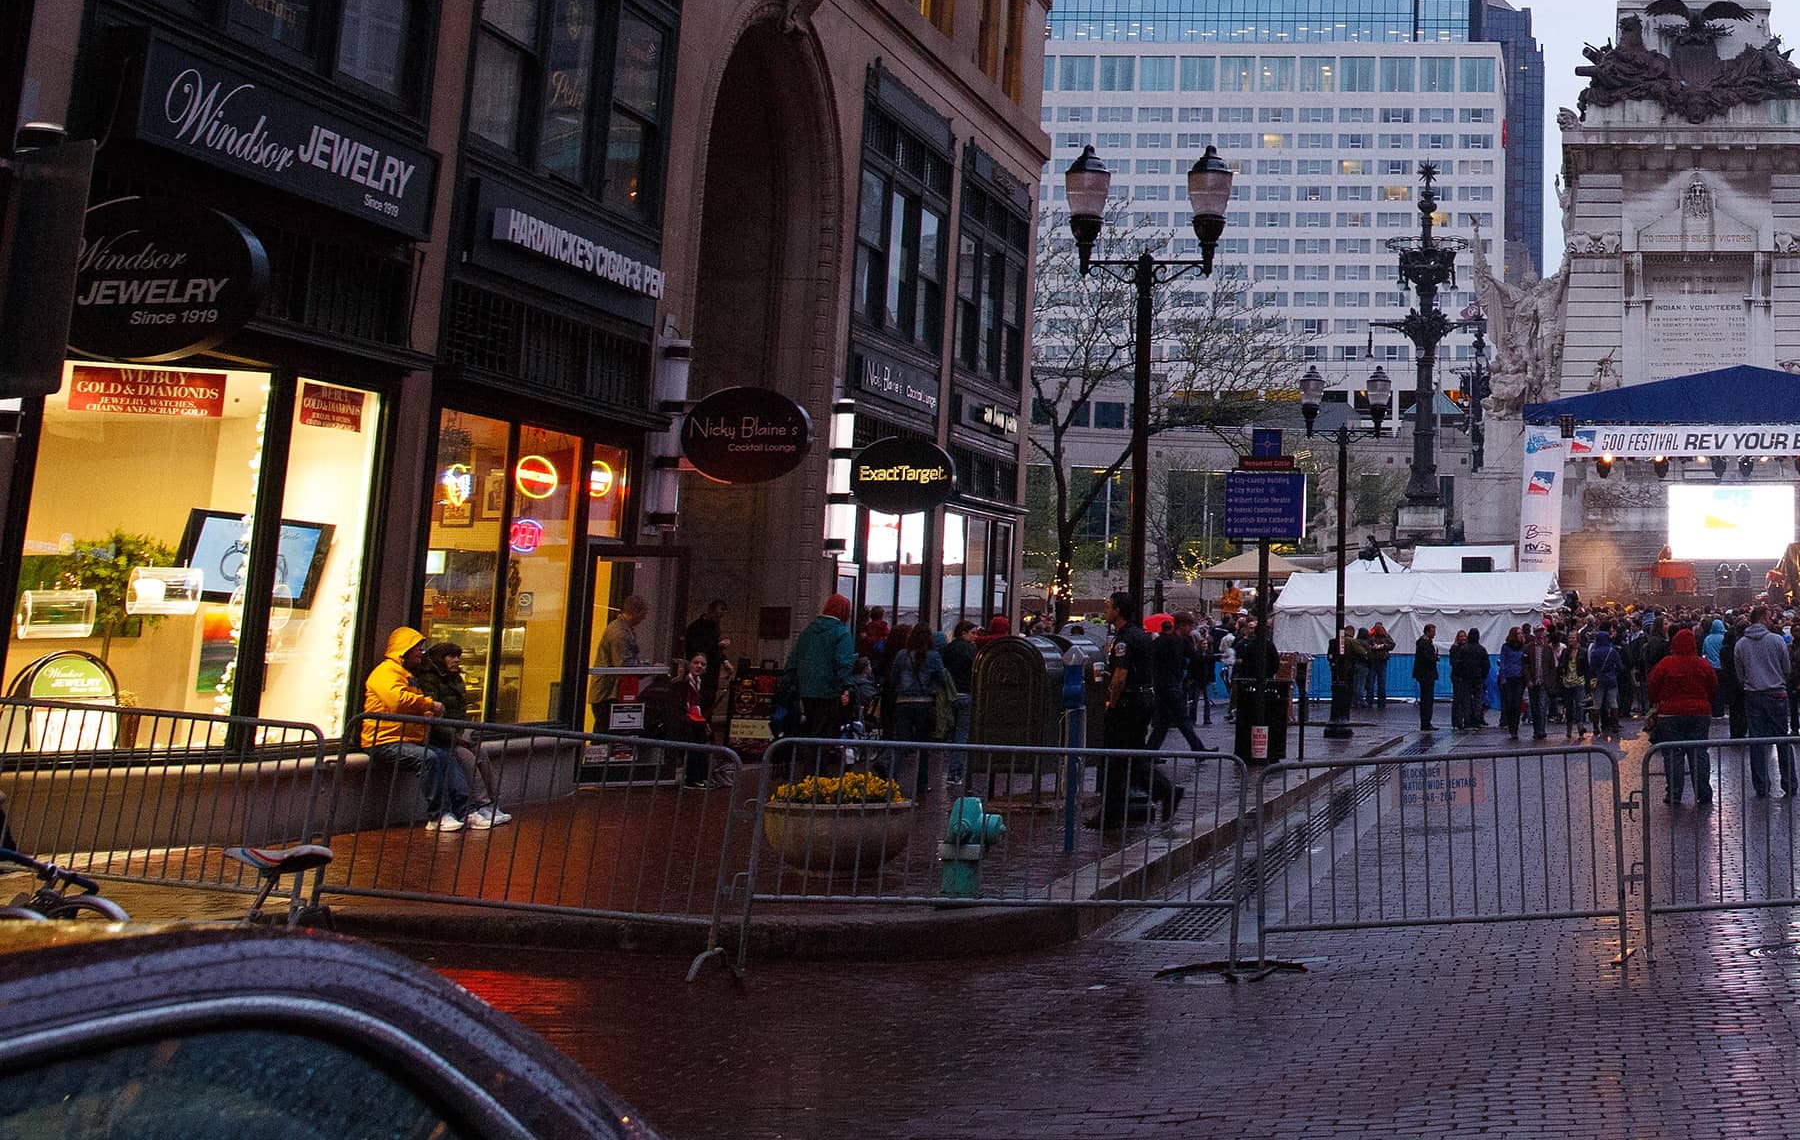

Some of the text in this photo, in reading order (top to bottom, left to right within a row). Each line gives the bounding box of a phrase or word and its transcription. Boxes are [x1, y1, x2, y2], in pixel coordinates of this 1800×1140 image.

[164, 68, 415, 198] Windsor JEWELRY
[363, 193, 400, 218] Since 1919
[508, 208, 666, 300] HARDWICKE'S CIGAR & PEN
[77, 277, 230, 306] JEWELRY
[129, 309, 219, 325] Since 1919
[120, 368, 189, 386] WE BUY
[76, 380, 219, 399] GOLD & DIAMONDS
[85, 403, 208, 417] CHAINS AND SCRAP GOLD
[689, 416, 799, 440] Nicky Blaine's
[727, 443, 797, 453] Cocktail Lounge
[1601, 433, 1625, 452] 500
[1627, 432, 1680, 452] FESTIVAL
[1683, 432, 1727, 451] REV
[1731, 431, 1790, 450] YOUR
[509, 522, 544, 548] OPEN
